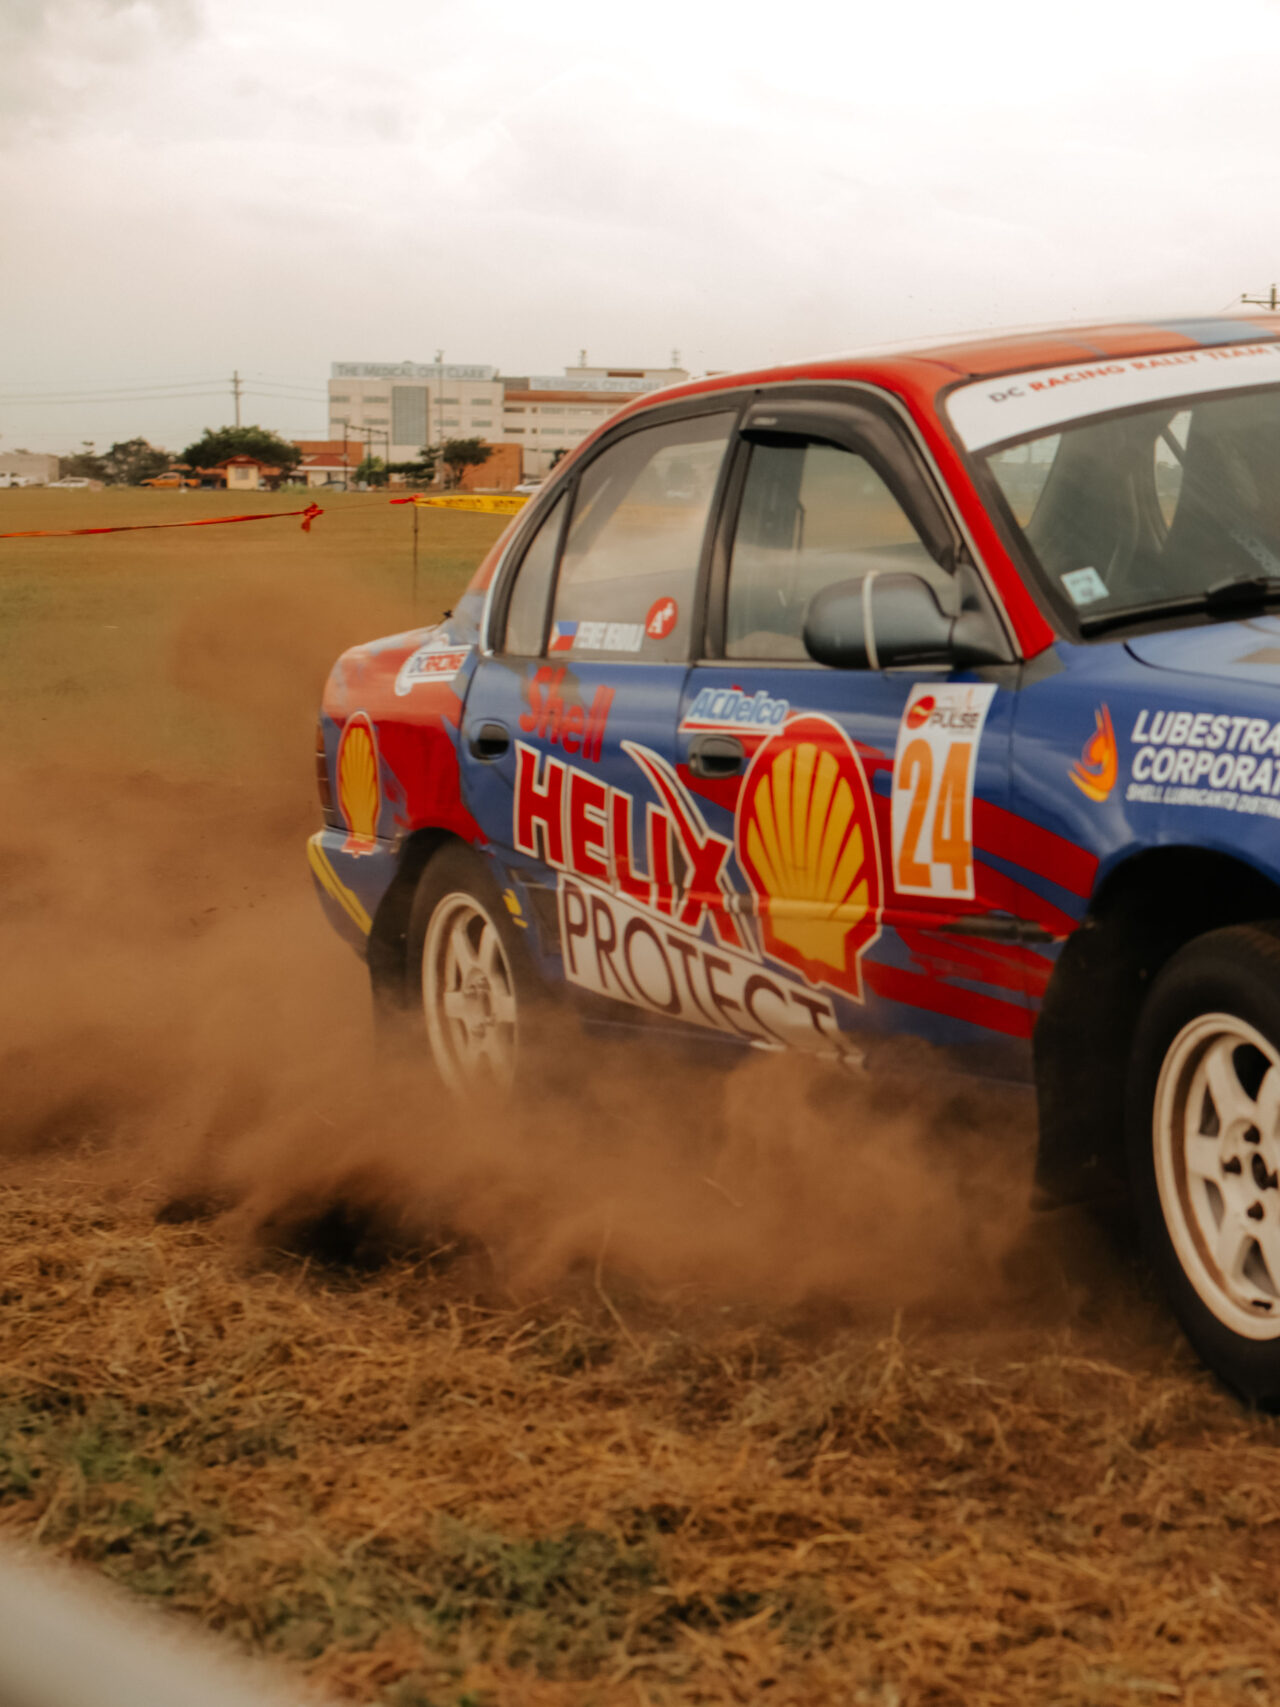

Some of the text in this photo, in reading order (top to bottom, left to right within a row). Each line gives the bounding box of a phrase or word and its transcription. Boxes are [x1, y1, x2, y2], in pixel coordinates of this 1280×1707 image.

[337, 365, 485, 379] THE MEDICAL CITY CLARK
[988, 387, 1025, 403] DC
[1028, 364, 1126, 392] RACING
[1130, 353, 1200, 371] RALLY
[1202, 346, 1271, 361] TEAM
[519, 666, 615, 763] Shell
[689, 690, 787, 726] ACDelco
[513, 740, 764, 963] HELIX
[898, 738, 972, 890] 24
[559, 876, 864, 1062] PROTECT
